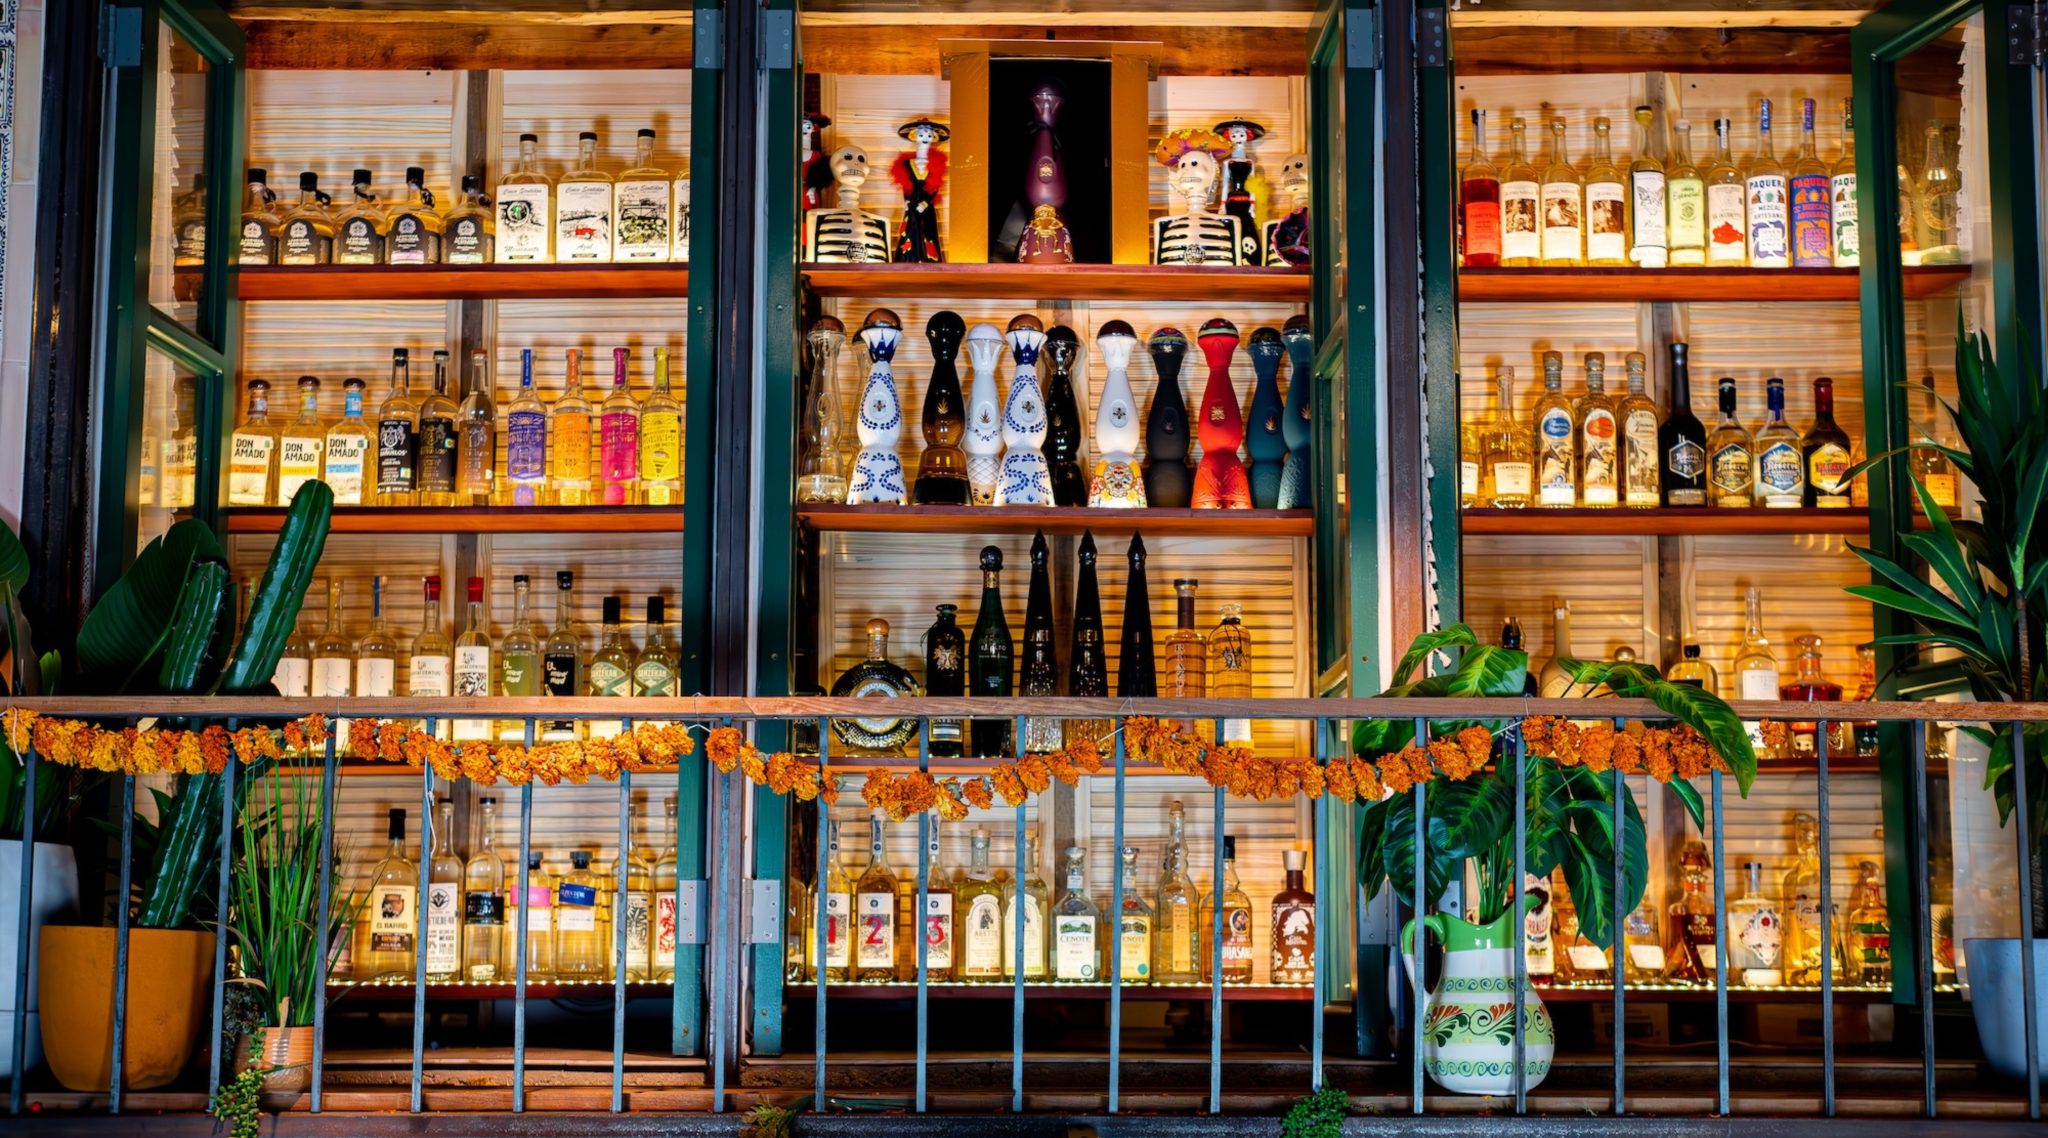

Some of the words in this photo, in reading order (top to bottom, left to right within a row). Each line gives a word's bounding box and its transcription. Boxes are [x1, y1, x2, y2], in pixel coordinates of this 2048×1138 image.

[1834, 176, 1856, 186] PAQU
[236, 438, 254, 448] DON
[286, 442, 303, 452] DON
[330, 438, 346, 448] DON
[234, 448, 265, 458] AMADO
[284, 452, 315, 462] AMADO
[328, 448, 358, 458] AMADO
[828, 915, 836, 944] 1
[866, 916, 884, 944] 2
[927, 916, 945, 944] 3
[1122, 935, 1146, 943] ENOTE
